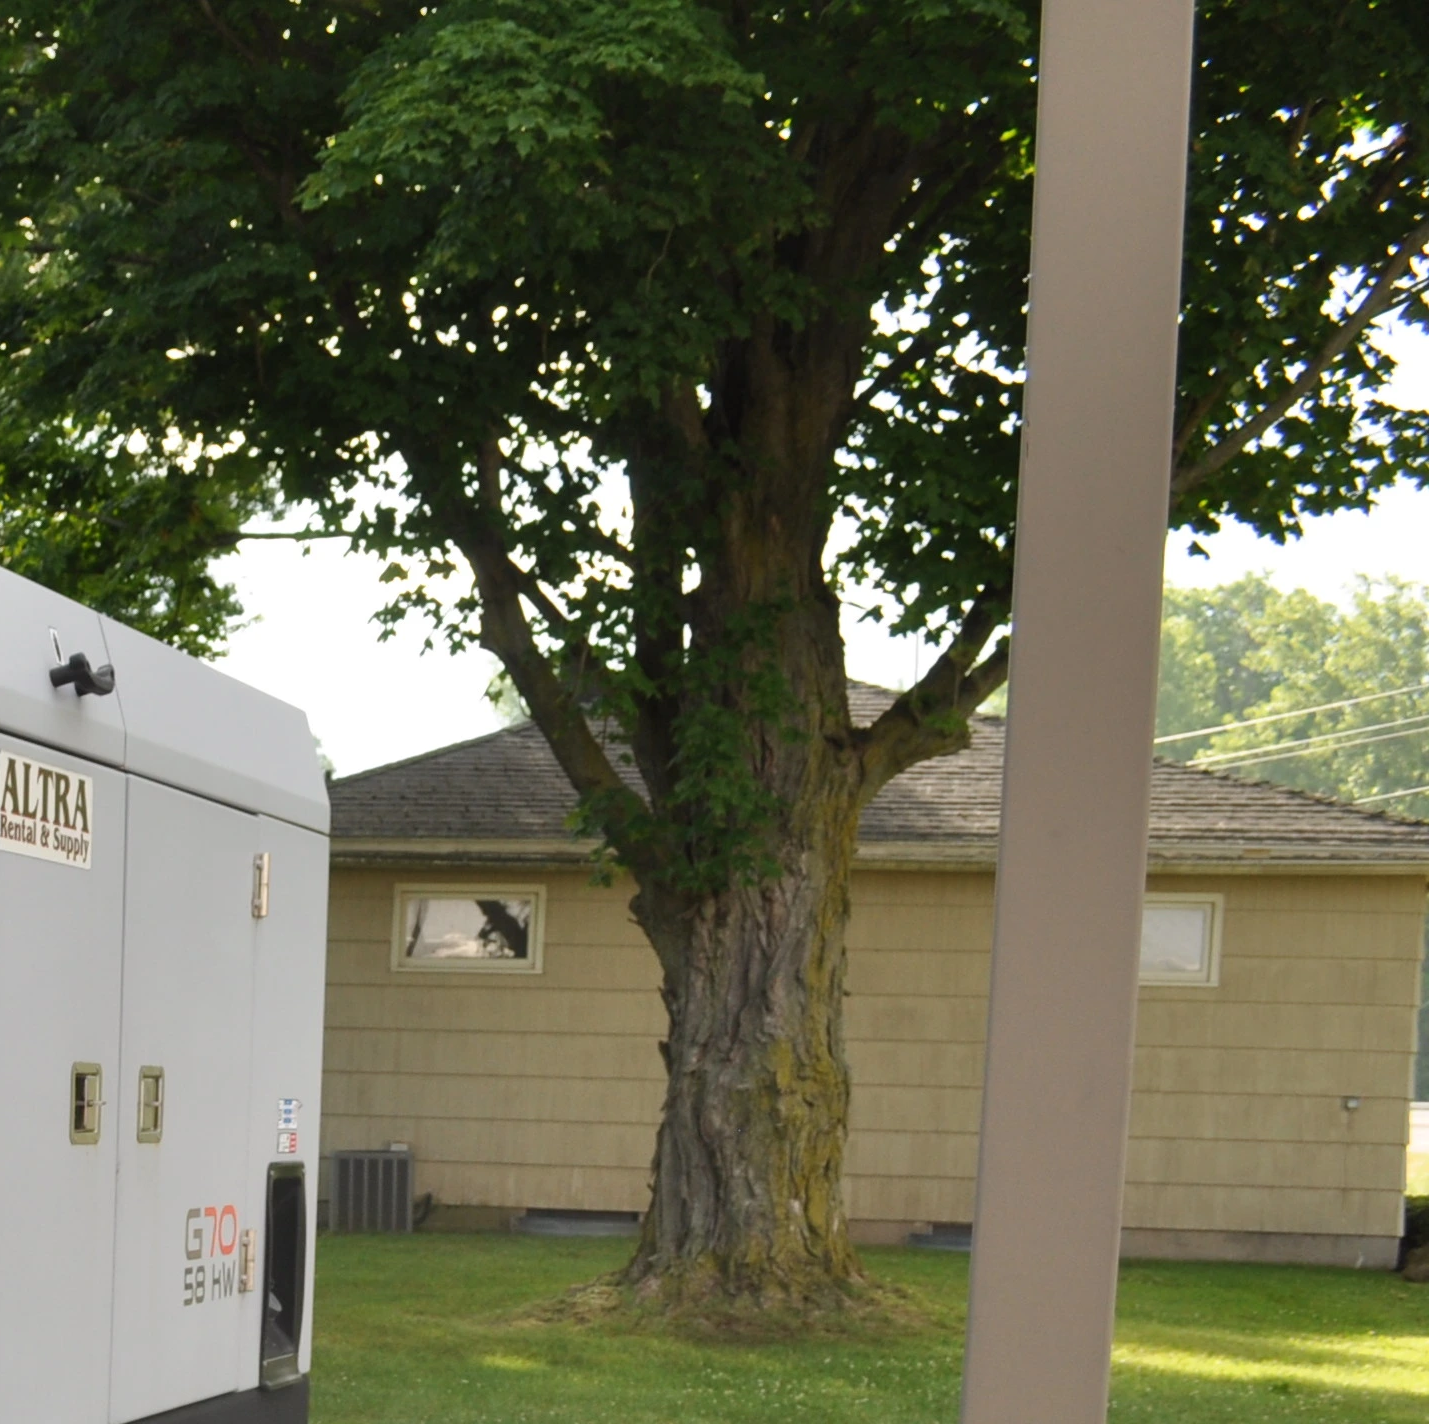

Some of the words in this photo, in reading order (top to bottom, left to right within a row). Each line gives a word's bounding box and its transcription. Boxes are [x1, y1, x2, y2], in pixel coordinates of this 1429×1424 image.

[0, 757, 90, 834] ALTRA
[0, 813, 37, 846] Rental
[40, 824, 50, 848] &
[53, 827, 90, 864] Supply
[185, 1204, 238, 1261] G70
[183, 1265, 206, 1307] 58
